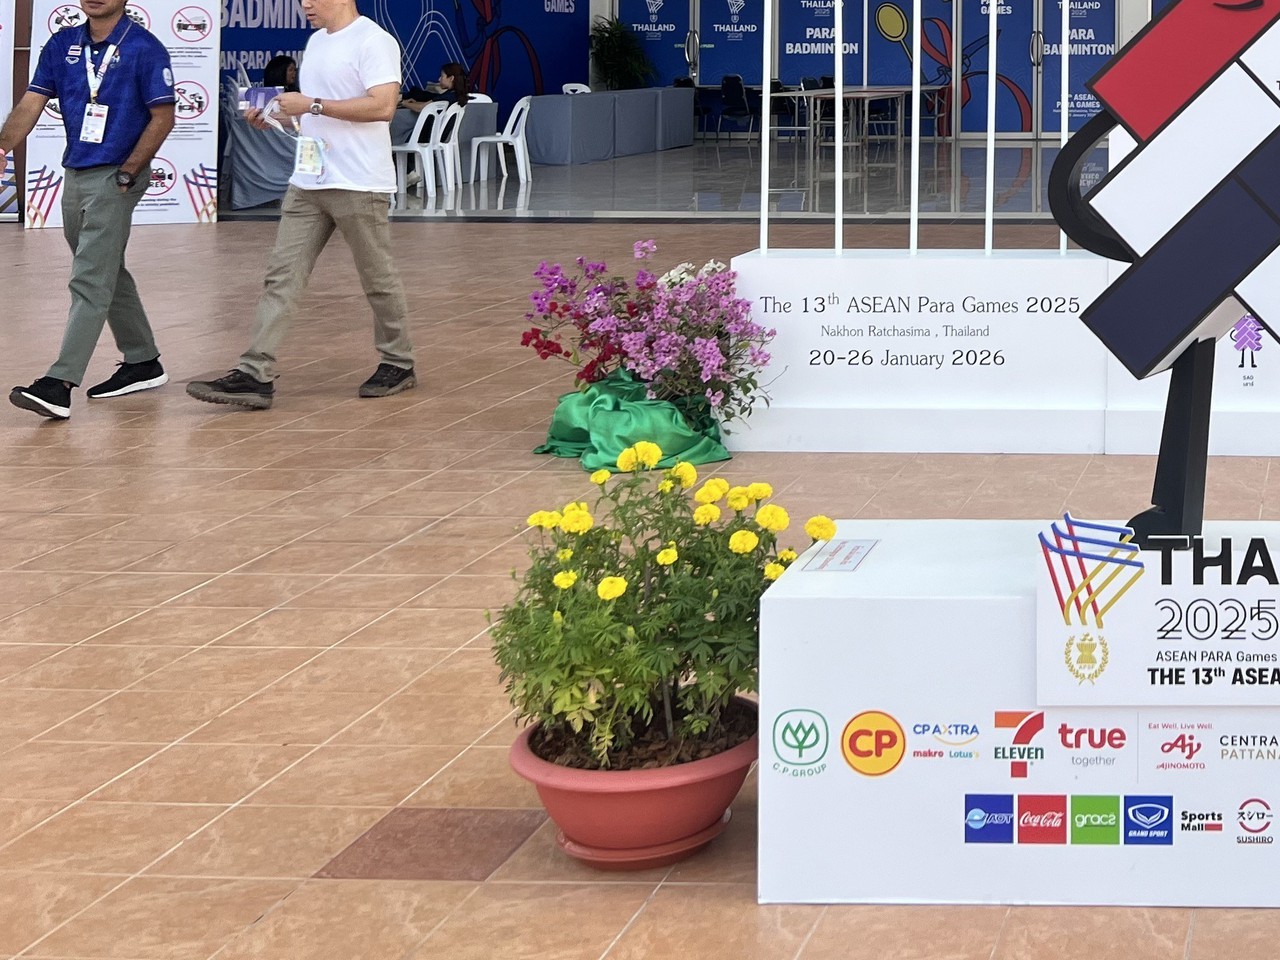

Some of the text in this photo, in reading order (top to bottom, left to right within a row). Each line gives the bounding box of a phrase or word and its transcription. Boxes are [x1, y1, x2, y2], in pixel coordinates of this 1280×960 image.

[801, 0, 844, 9] THAILAN
[632, 24, 676, 32] THAILAND
[713, 24, 757, 33] THAILAND
[1044, 44, 1115, 55] BAMINTON
[760, 292, 1081, 314] The 13th ASEAN Para Games 2025
[821, 325, 864, 337] Nakhon
[868, 324, 931, 337] Ratchasima
[943, 325, 990, 337] Thailand
[809, 349, 1005, 370] 20-26 January 2026
[1154, 597, 1280, 641] 2025
[1156, 650, 1278, 662] ASEAN PARA Games
[1148, 668, 1187, 685] THE
[1192, 667, 1226, 686] 13th
[1058, 723, 1127, 749] true
[848, 728, 898, 758] CP
[912, 748, 944, 758] makro
[1071, 756, 1116, 768] together
[1181, 810, 1223, 822] Sports
[1181, 823, 1204, 832] Mall
[1128, 830, 1169, 838] GRAND SPORT
[1236, 836, 1274, 844] SUSHIRO
